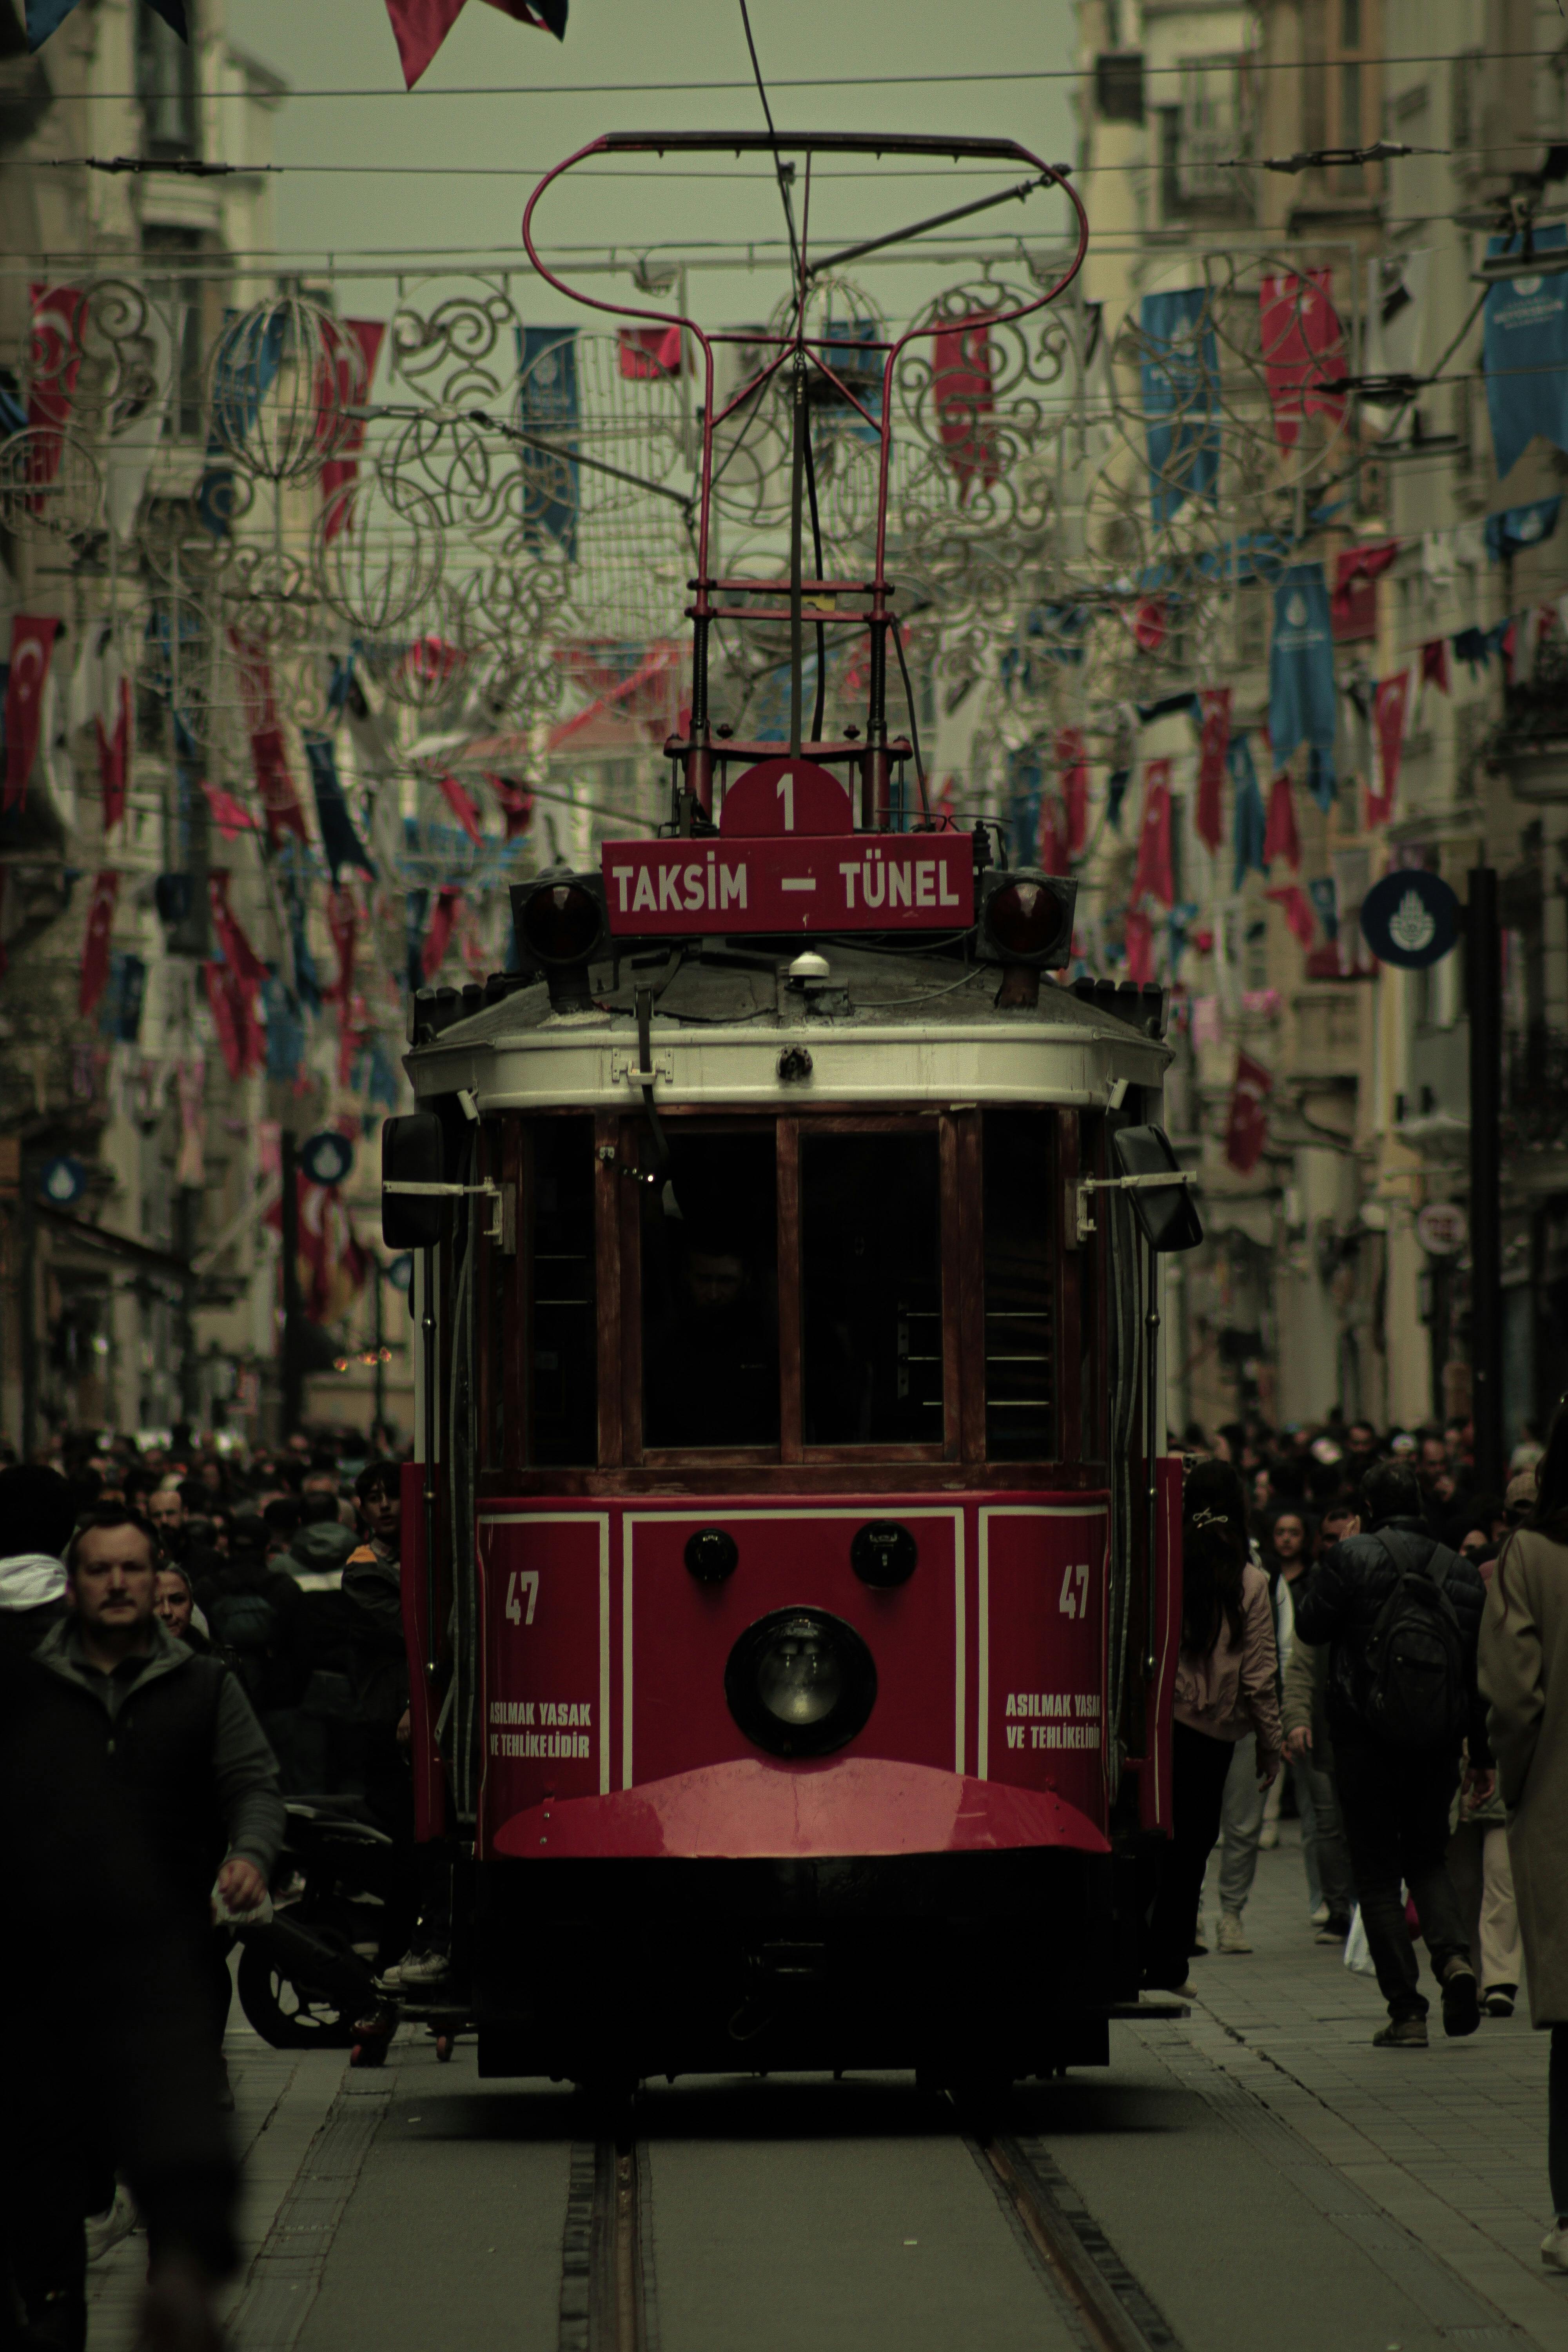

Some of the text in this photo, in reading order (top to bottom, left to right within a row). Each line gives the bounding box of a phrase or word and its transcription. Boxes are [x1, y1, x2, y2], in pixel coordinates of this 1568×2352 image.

[777, 773, 794, 831] 1
[612, 851, 748, 912] TAKSİM
[839, 849, 959, 908] TÜNEL
[506, 1570, 539, 1626] 47
[1059, 1565, 1089, 1619] 47
[490, 1702, 591, 1727] ASILMAK YASAK
[1006, 1693, 1071, 1717] ASILMAK
[490, 1733, 499, 1756] VE
[1007, 1725, 1025, 1749] VE
